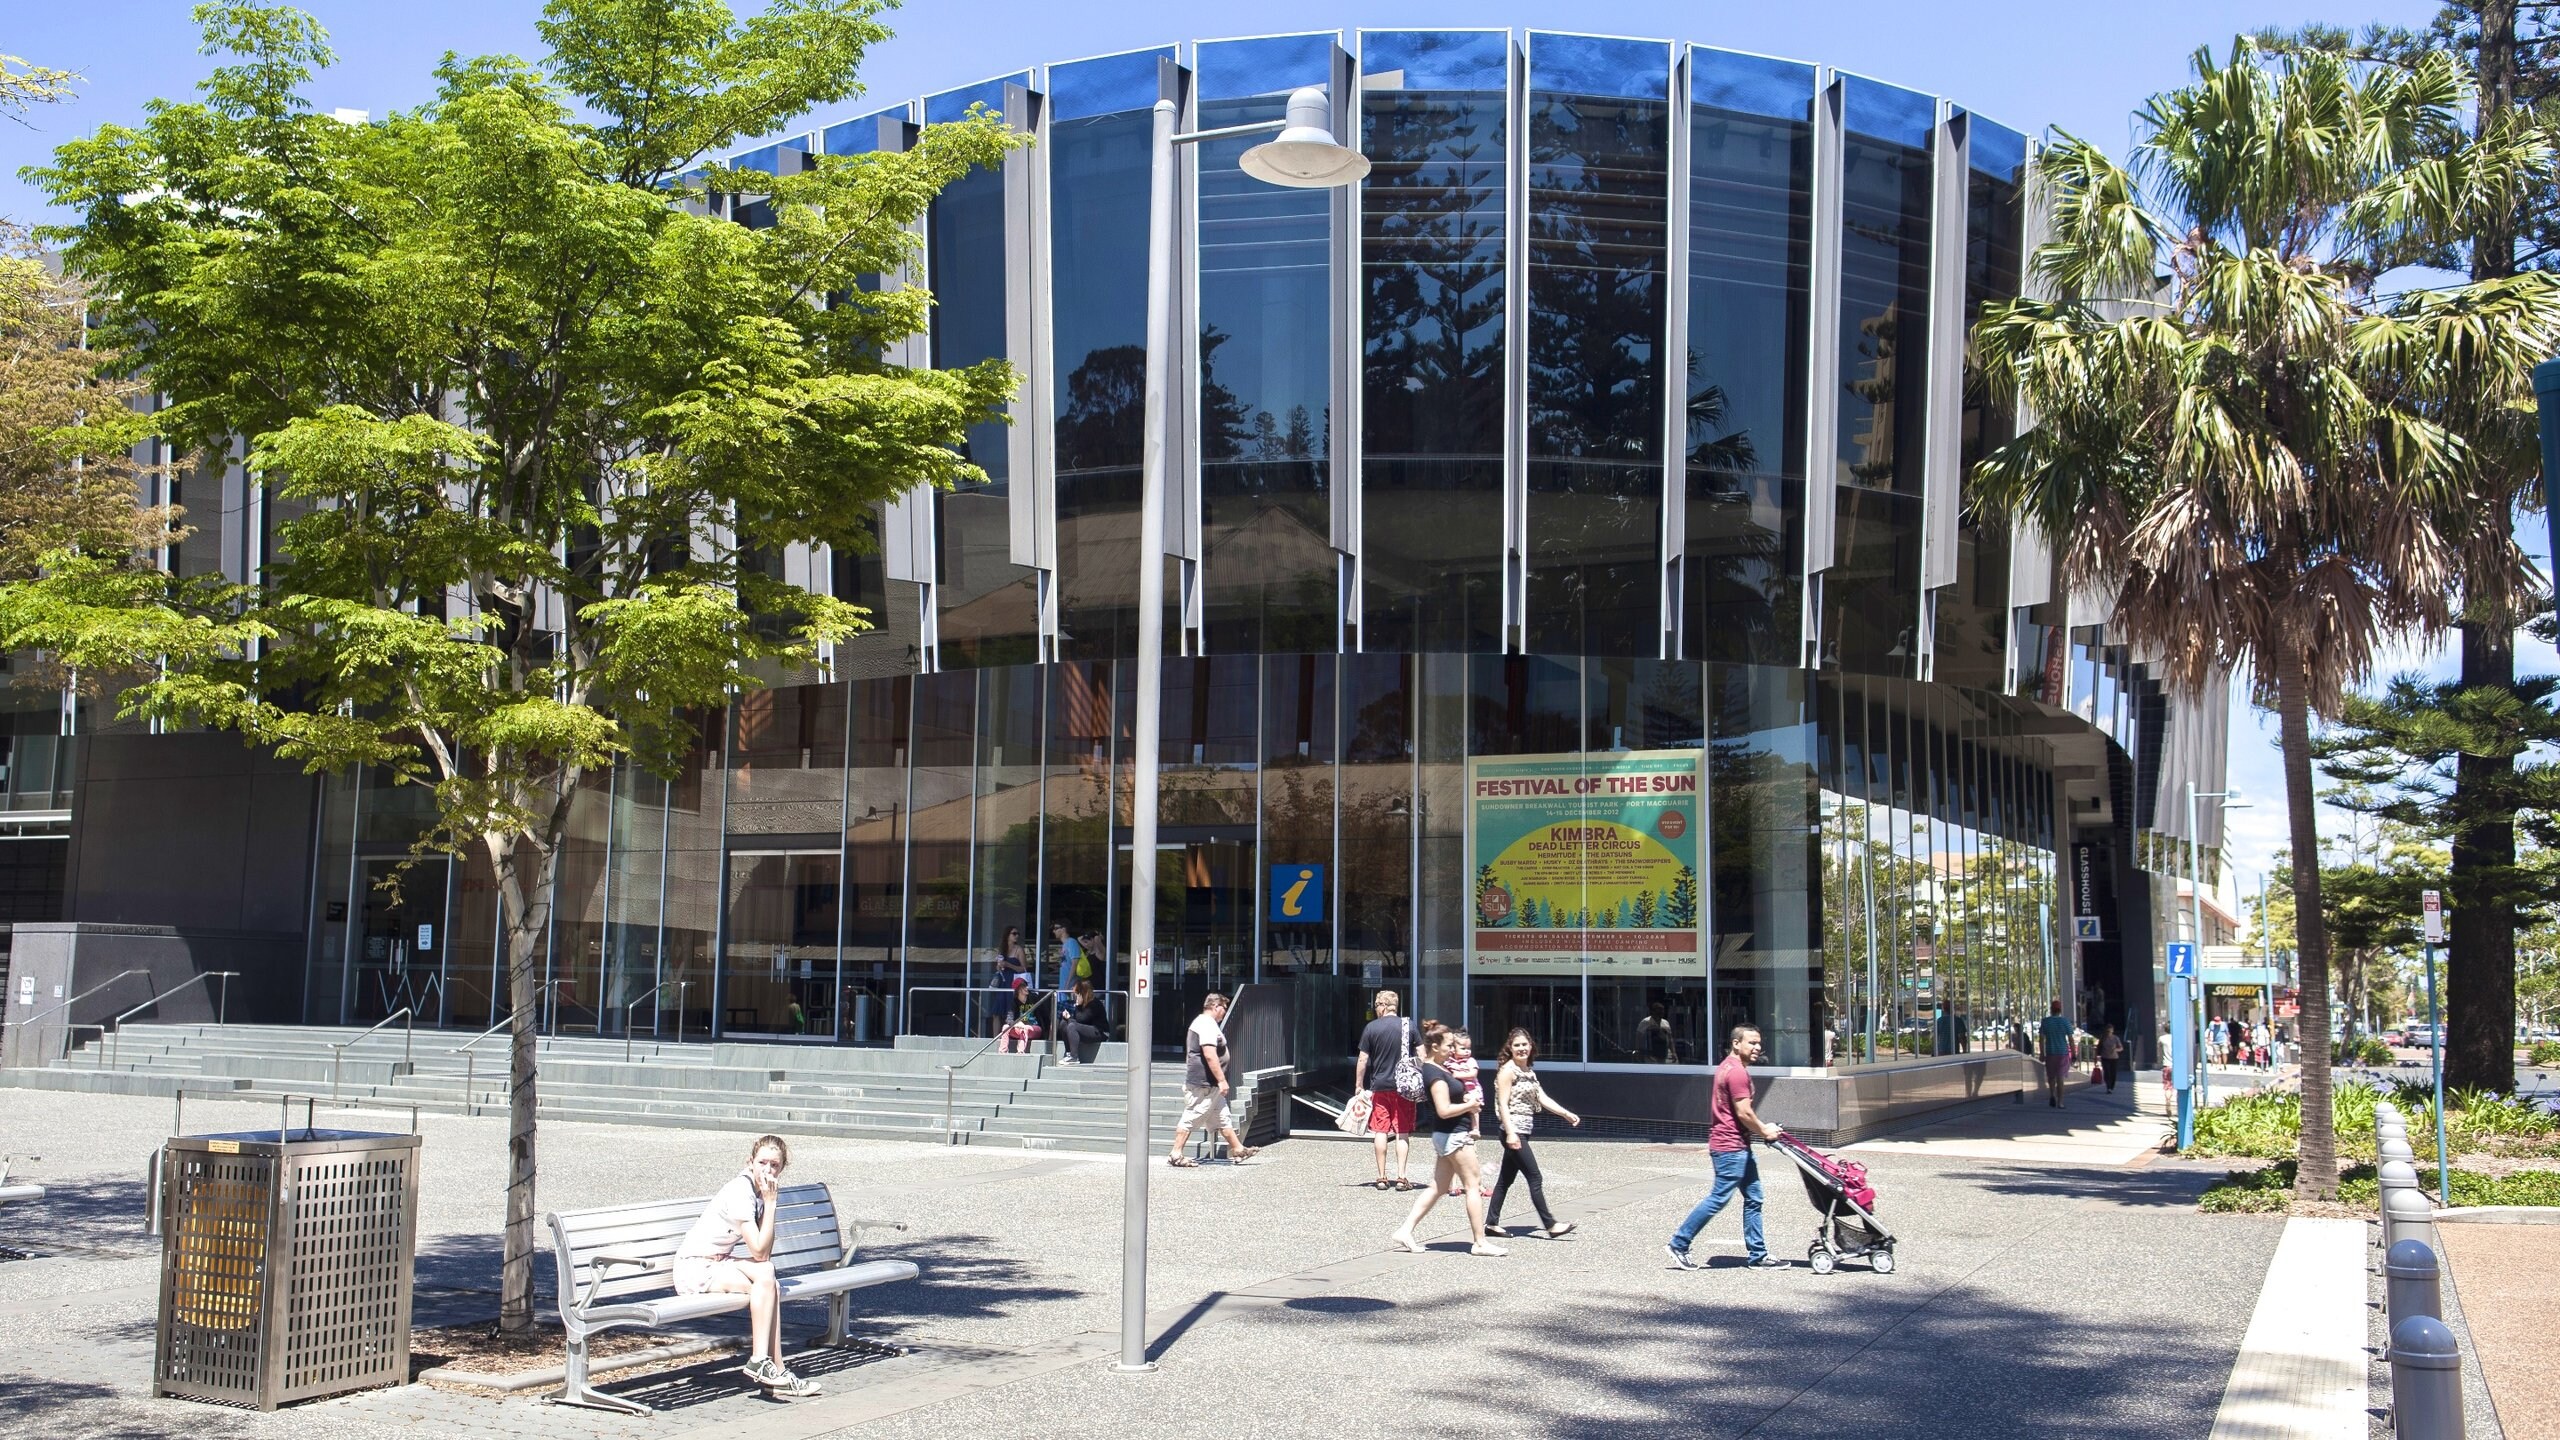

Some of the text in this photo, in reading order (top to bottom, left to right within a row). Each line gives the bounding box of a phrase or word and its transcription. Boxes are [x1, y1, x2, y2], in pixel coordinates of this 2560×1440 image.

[1476, 775, 1696, 797] FESTIVAL OF THE SUN
[1550, 827, 1618, 841] KIMBRA
[1528, 840, 1641, 851] DEAD LETTER CIRCUS
[2080, 847, 2091, 914] GLASSHOUSE
[936, 900, 960, 911] BAR
[1139, 949, 1148, 965] H
[1138, 979, 1147, 994] P
[2211, 985, 2262, 996] SUBWAY
